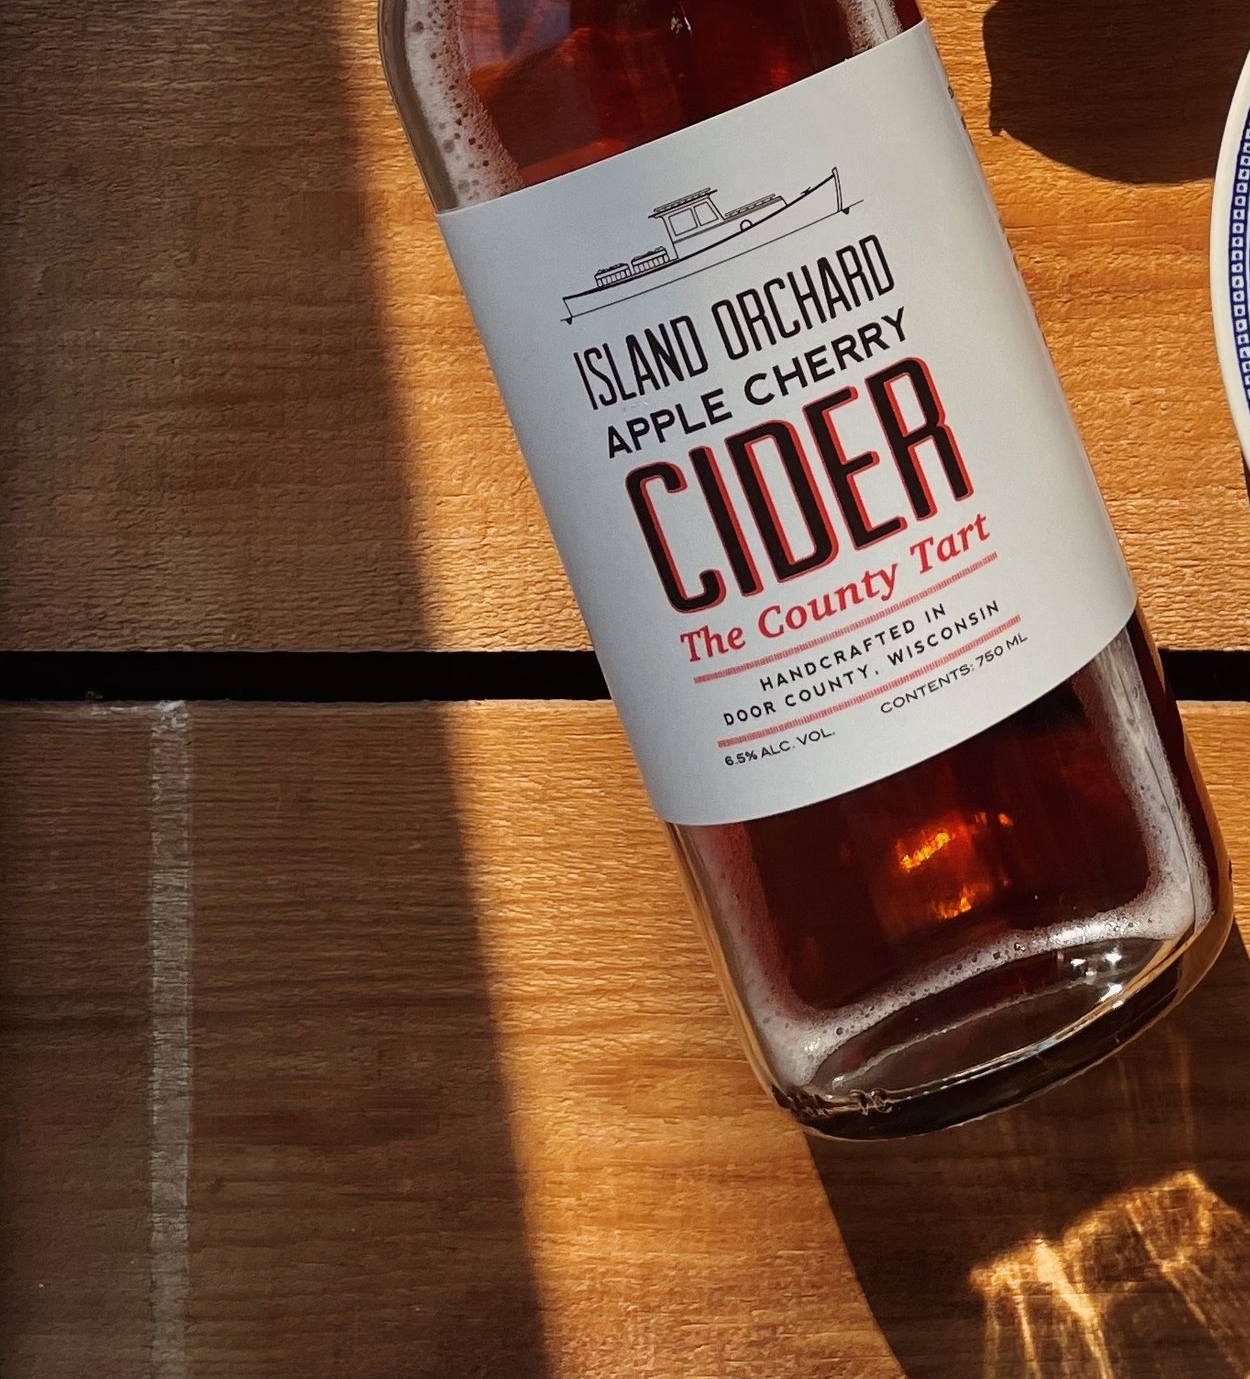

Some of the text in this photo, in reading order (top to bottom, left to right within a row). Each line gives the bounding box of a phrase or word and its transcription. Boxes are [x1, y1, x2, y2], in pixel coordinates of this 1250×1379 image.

[573, 234, 895, 410] ISLAND ORCHARD
[608, 306, 906, 459] APPLE CHERRY
[625, 356, 975, 614] CIDER
[680, 513, 990, 663] The County Tart
[760, 603, 947, 691] HANDCRAFTED IN
[724, 600, 1000, 726] DOOR COUNTY, WISCONSIN
[880, 633, 1028, 714] CONTENTS: 750 ML
[724, 728, 835, 766] 6.5% ALC. VOL.
